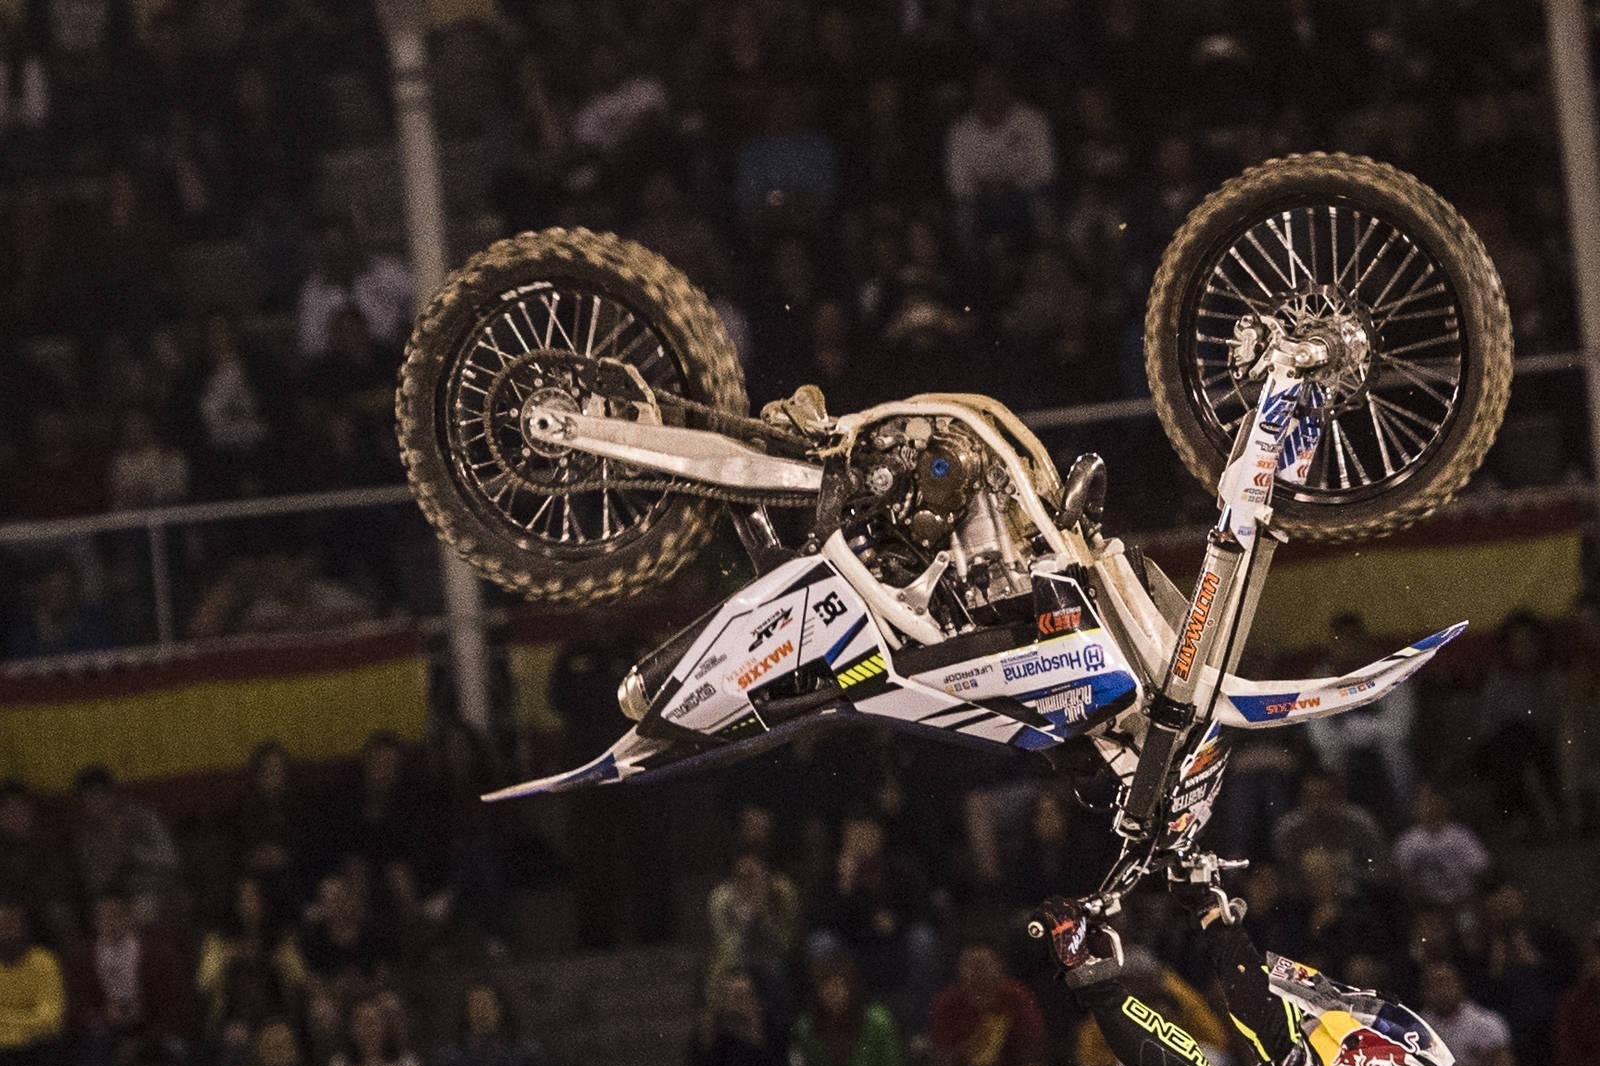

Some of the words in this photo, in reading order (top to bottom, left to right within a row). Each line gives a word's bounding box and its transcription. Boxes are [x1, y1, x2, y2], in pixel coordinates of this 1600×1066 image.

[1173, 571, 1220, 681] ULTIMATE
[737, 640, 794, 691] MAXXIS
[944, 664, 994, 685] LIFEPROOF
[1003, 652, 1081, 683] Husqvarna
[1267, 697, 1320, 715] MAXXIS
